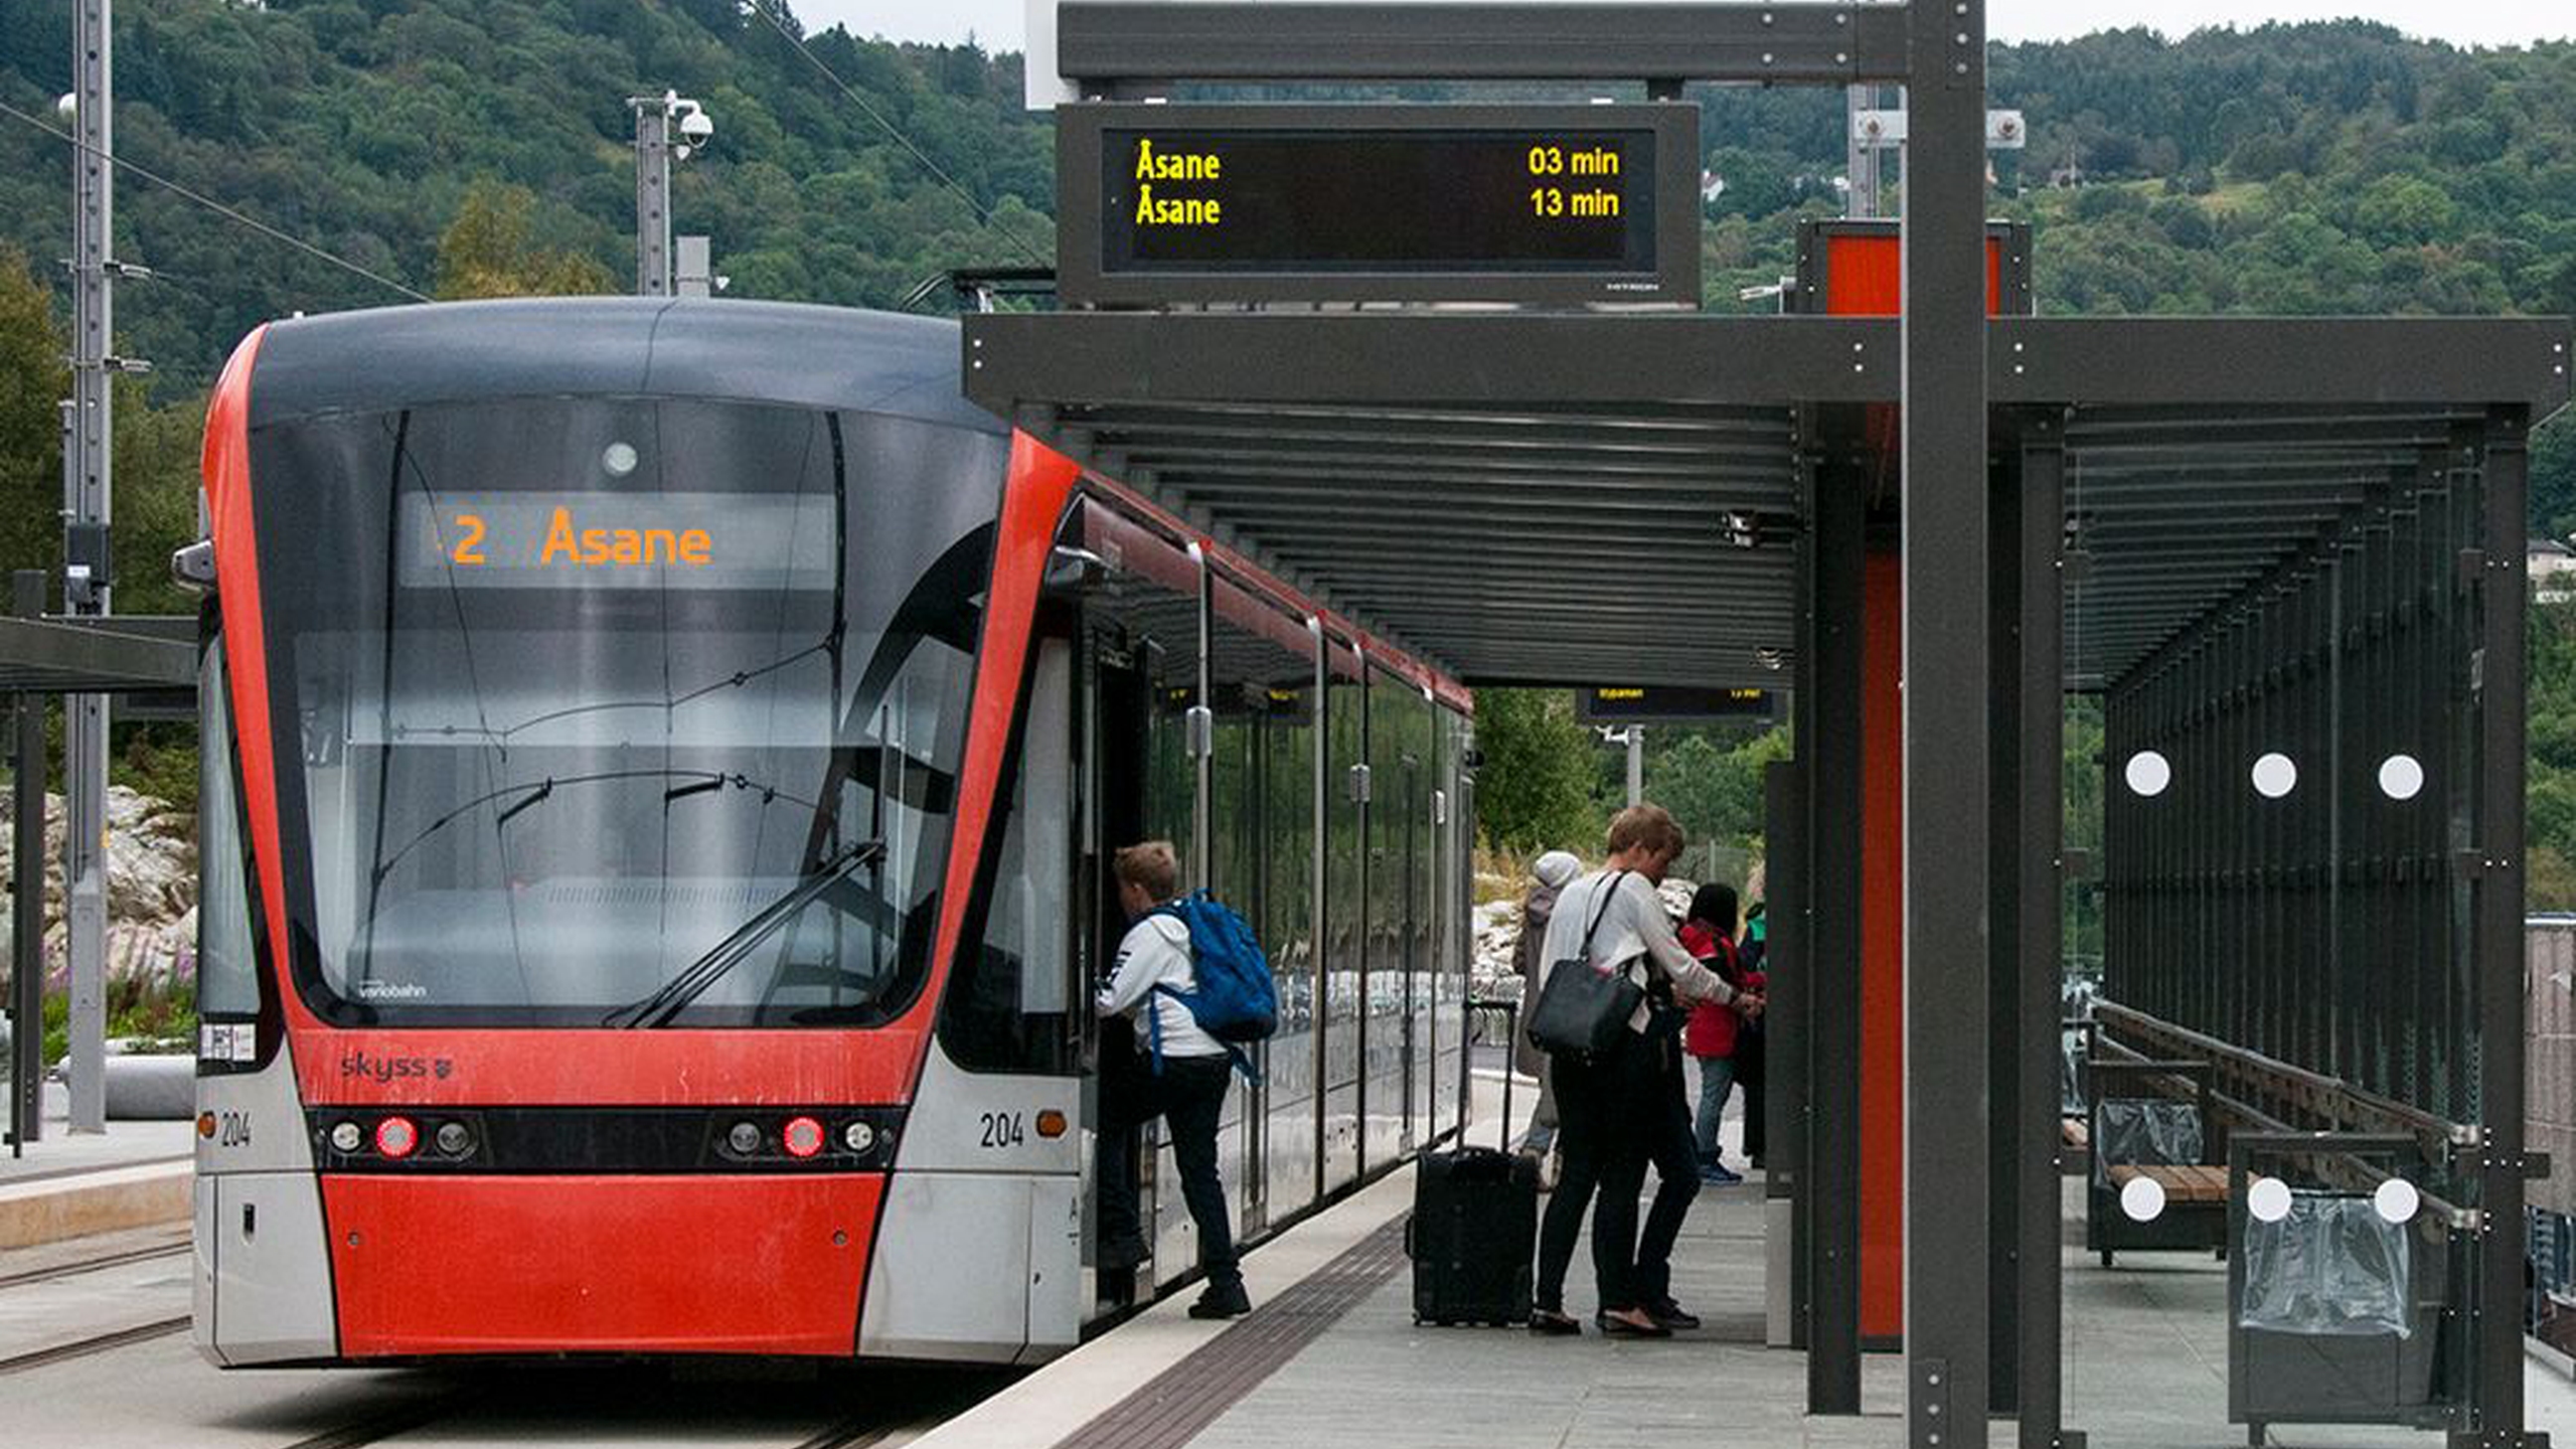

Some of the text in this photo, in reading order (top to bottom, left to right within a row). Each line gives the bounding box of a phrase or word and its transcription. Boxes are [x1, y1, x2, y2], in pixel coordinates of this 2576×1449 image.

[1135, 138, 1619, 180] Åsane 03 min
[1135, 184, 1619, 226] Åsane 13 min
[452, 505, 713, 565] 2 Åsane
[341, 1050, 427, 1084] skyss
[222, 1111, 250, 1148] 204
[980, 1111, 1025, 1148] 204
